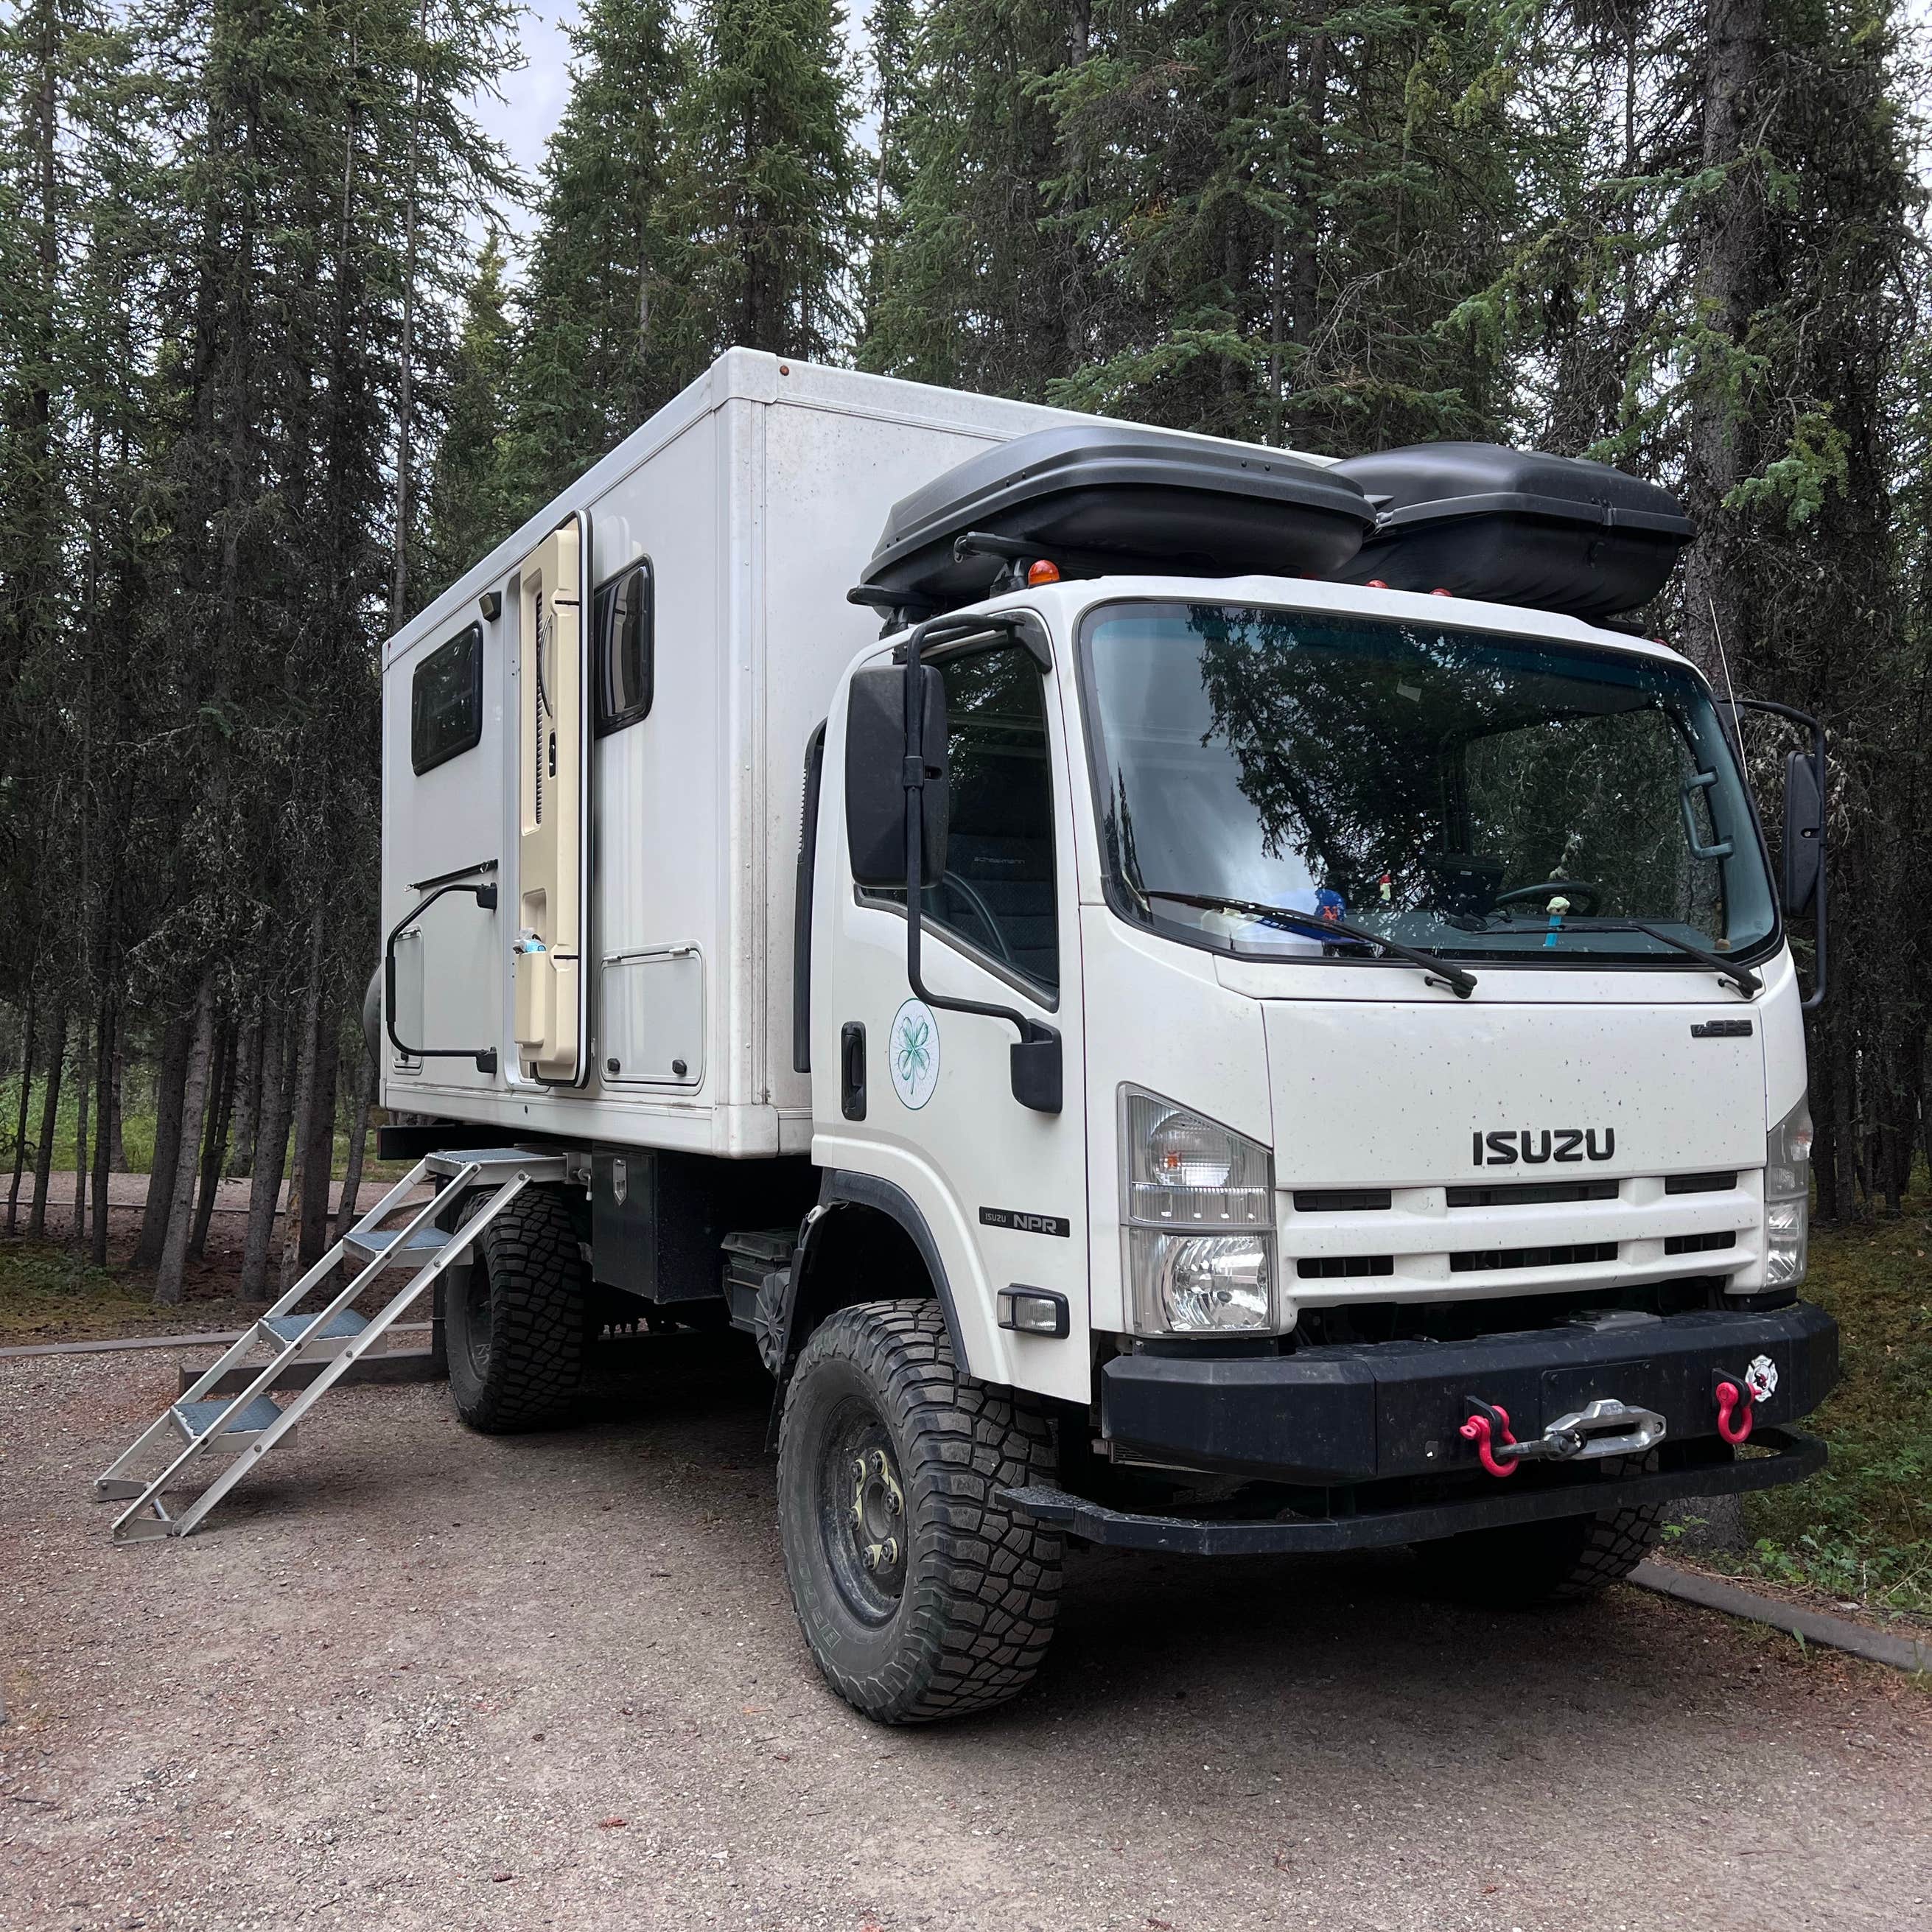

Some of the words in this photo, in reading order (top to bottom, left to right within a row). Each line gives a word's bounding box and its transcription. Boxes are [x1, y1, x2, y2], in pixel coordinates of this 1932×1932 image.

[1473, 1127, 1615, 1166] ISUZU
[985, 1213, 1006, 1223] ISUZU
[1013, 1214, 1057, 1233] NPR
